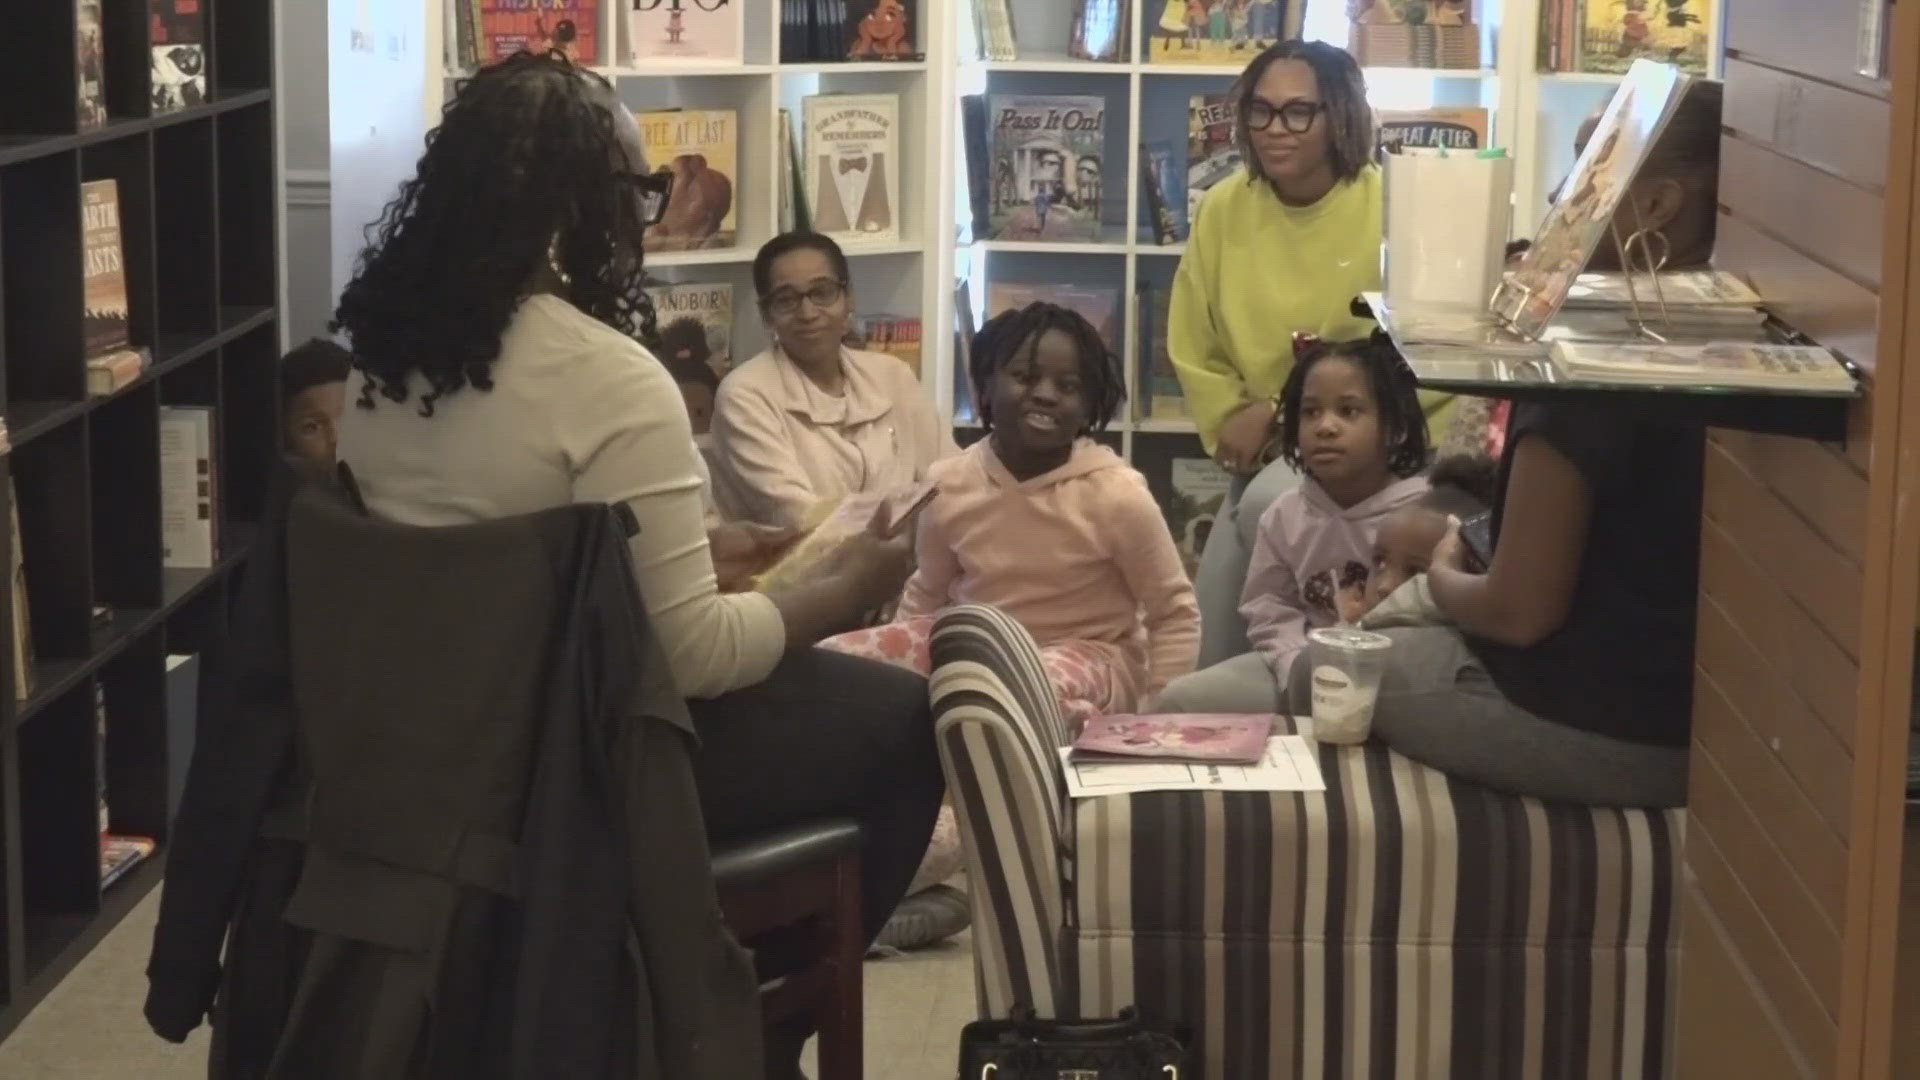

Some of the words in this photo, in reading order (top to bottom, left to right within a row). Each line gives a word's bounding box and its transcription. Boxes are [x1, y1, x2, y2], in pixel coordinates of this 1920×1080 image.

[999, 108, 1041, 130] Pass
[1043, 109, 1060, 130] It
[1062, 109, 1104, 131] On!
[696, 119, 726, 145] LAST
[1428, 127, 1473, 148] AFTER
